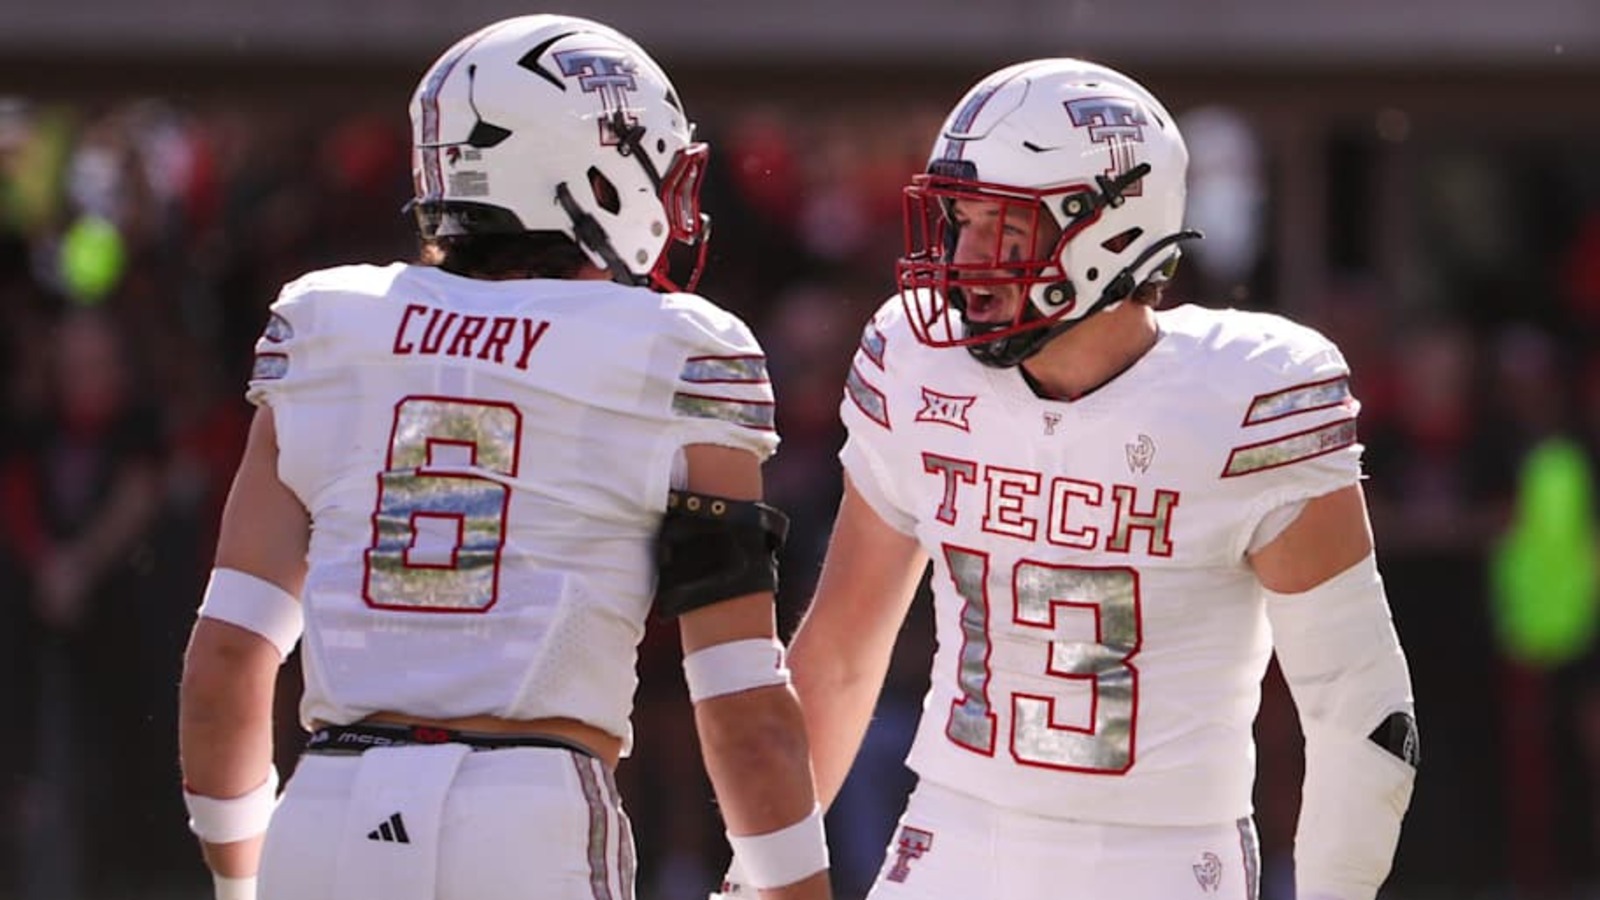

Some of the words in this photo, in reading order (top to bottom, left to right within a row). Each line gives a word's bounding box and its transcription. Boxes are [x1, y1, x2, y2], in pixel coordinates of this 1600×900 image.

[392, 303, 550, 371] CURRY
[915, 386, 977, 432] XII
[362, 395, 523, 614] 8
[921, 451, 1180, 557] TECH
[942, 542, 1142, 776] 13
